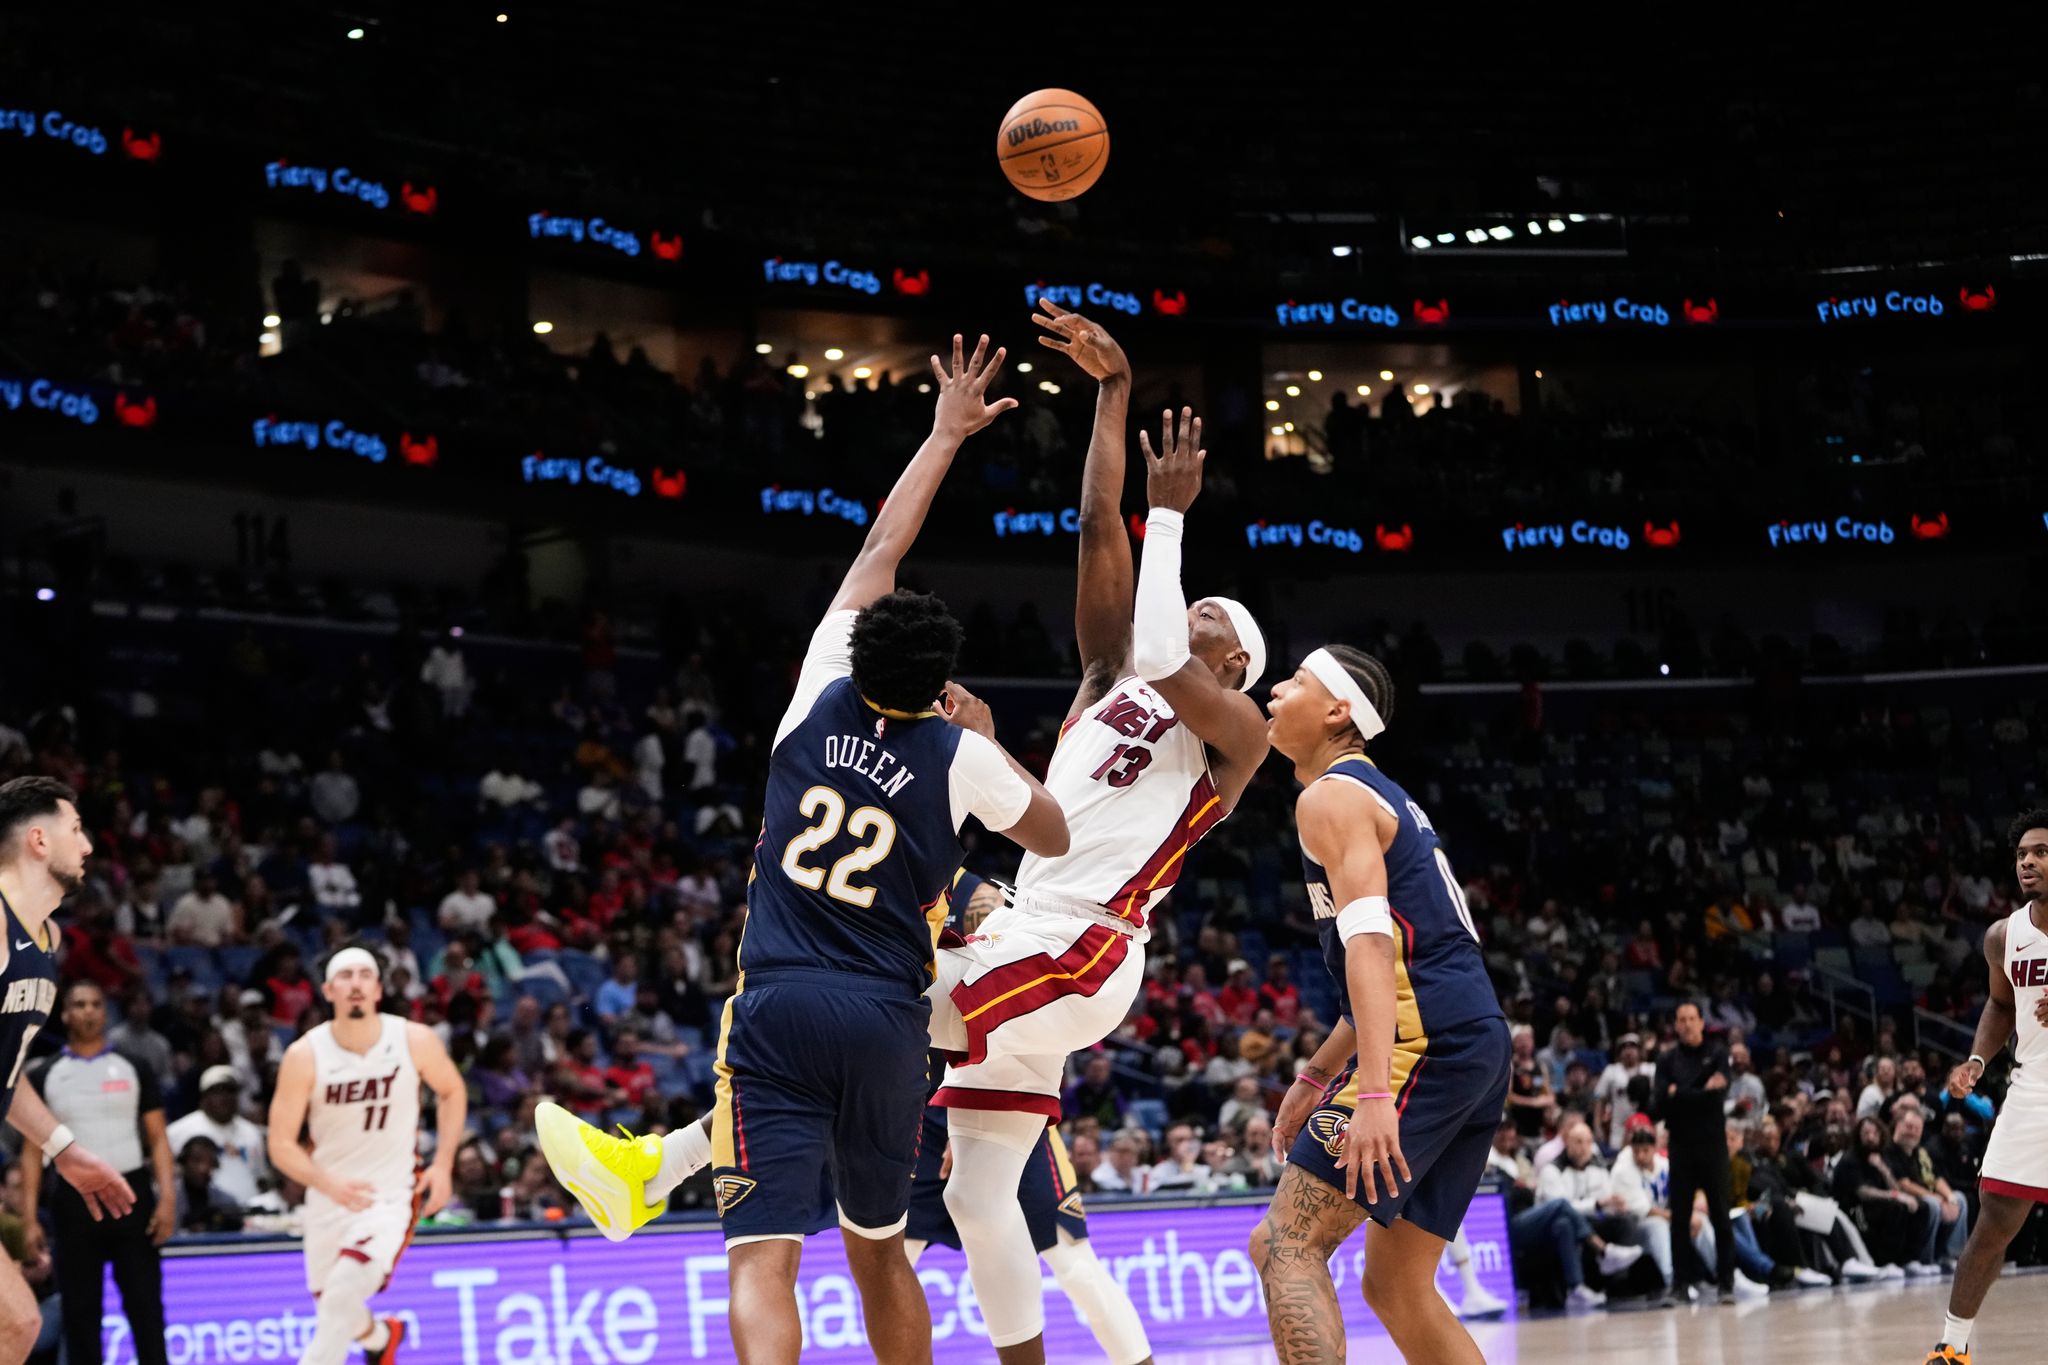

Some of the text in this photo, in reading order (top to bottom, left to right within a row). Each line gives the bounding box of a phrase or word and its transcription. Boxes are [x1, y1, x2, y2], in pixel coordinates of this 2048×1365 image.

[43, 111, 107, 155] Crab
[1007, 116, 1078, 147] Wilson
[266, 160, 389, 209] Fiery Crab
[528, 211, 640, 257] Fiery Crab
[764, 257, 880, 295] Fiery Crab
[1086, 283, 1141, 316] Crab
[1276, 298, 1400, 327] Fiery Crab
[1549, 298, 1669, 326] Fiery Crab
[1817, 291, 1943, 323] Fiery Crab
[29, 379, 98, 424] Crab
[253, 416, 387, 462] Fiery Crab
[522, 453, 641, 497] Fiery Crab
[761, 486, 868, 527] Fiery Crab
[993, 507, 1055, 537] Fiery
[1246, 520, 1363, 553] Fiery Crab
[1502, 520, 1630, 552] Fiery Crab
[1768, 516, 1894, 547] Fiery Crab
[826, 735, 915, 798] QUEEN
[1090, 744, 1152, 788] 13
[781, 785, 897, 909] 22
[2011, 958, 2048, 987] HE
[326, 1065, 400, 1105] HEAT
[364, 1105, 389, 1131] 11
[432, 1263, 660, 1365] Take
